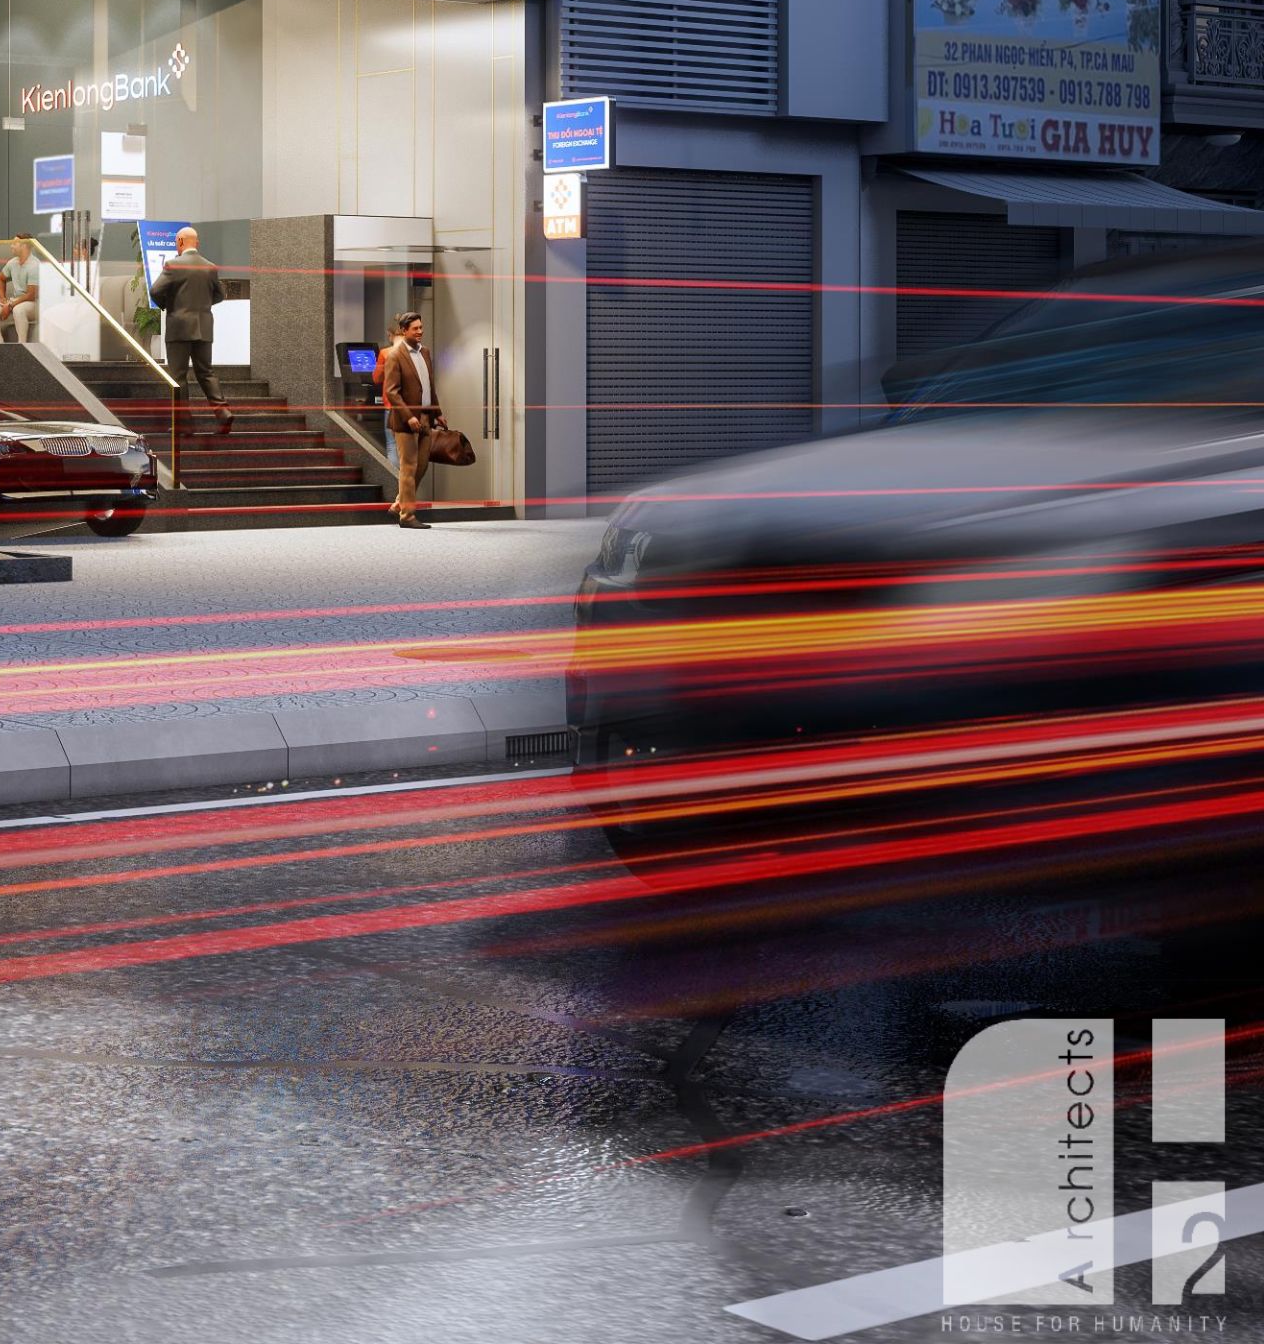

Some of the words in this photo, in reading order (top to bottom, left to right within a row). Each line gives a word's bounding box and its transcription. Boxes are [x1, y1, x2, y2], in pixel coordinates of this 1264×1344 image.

[944, 42, 958, 61] 32
[961, 43, 995, 64] PHAN
[995, 46, 1026, 70] NGỌC
[1111, 53, 1135, 73] MAU
[21, 67, 171, 114] KienlongBank
[927, 70, 949, 97] ĐT:
[953, 72, 1046, 103] 0913.397539
[1059, 79, 1122, 108] 0913.788
[1126, 83, 1151, 110] 798
[1040, 118, 1091, 155] GIA
[1098, 123, 1154, 158] HUY
[547, 216, 577, 233] ATM
